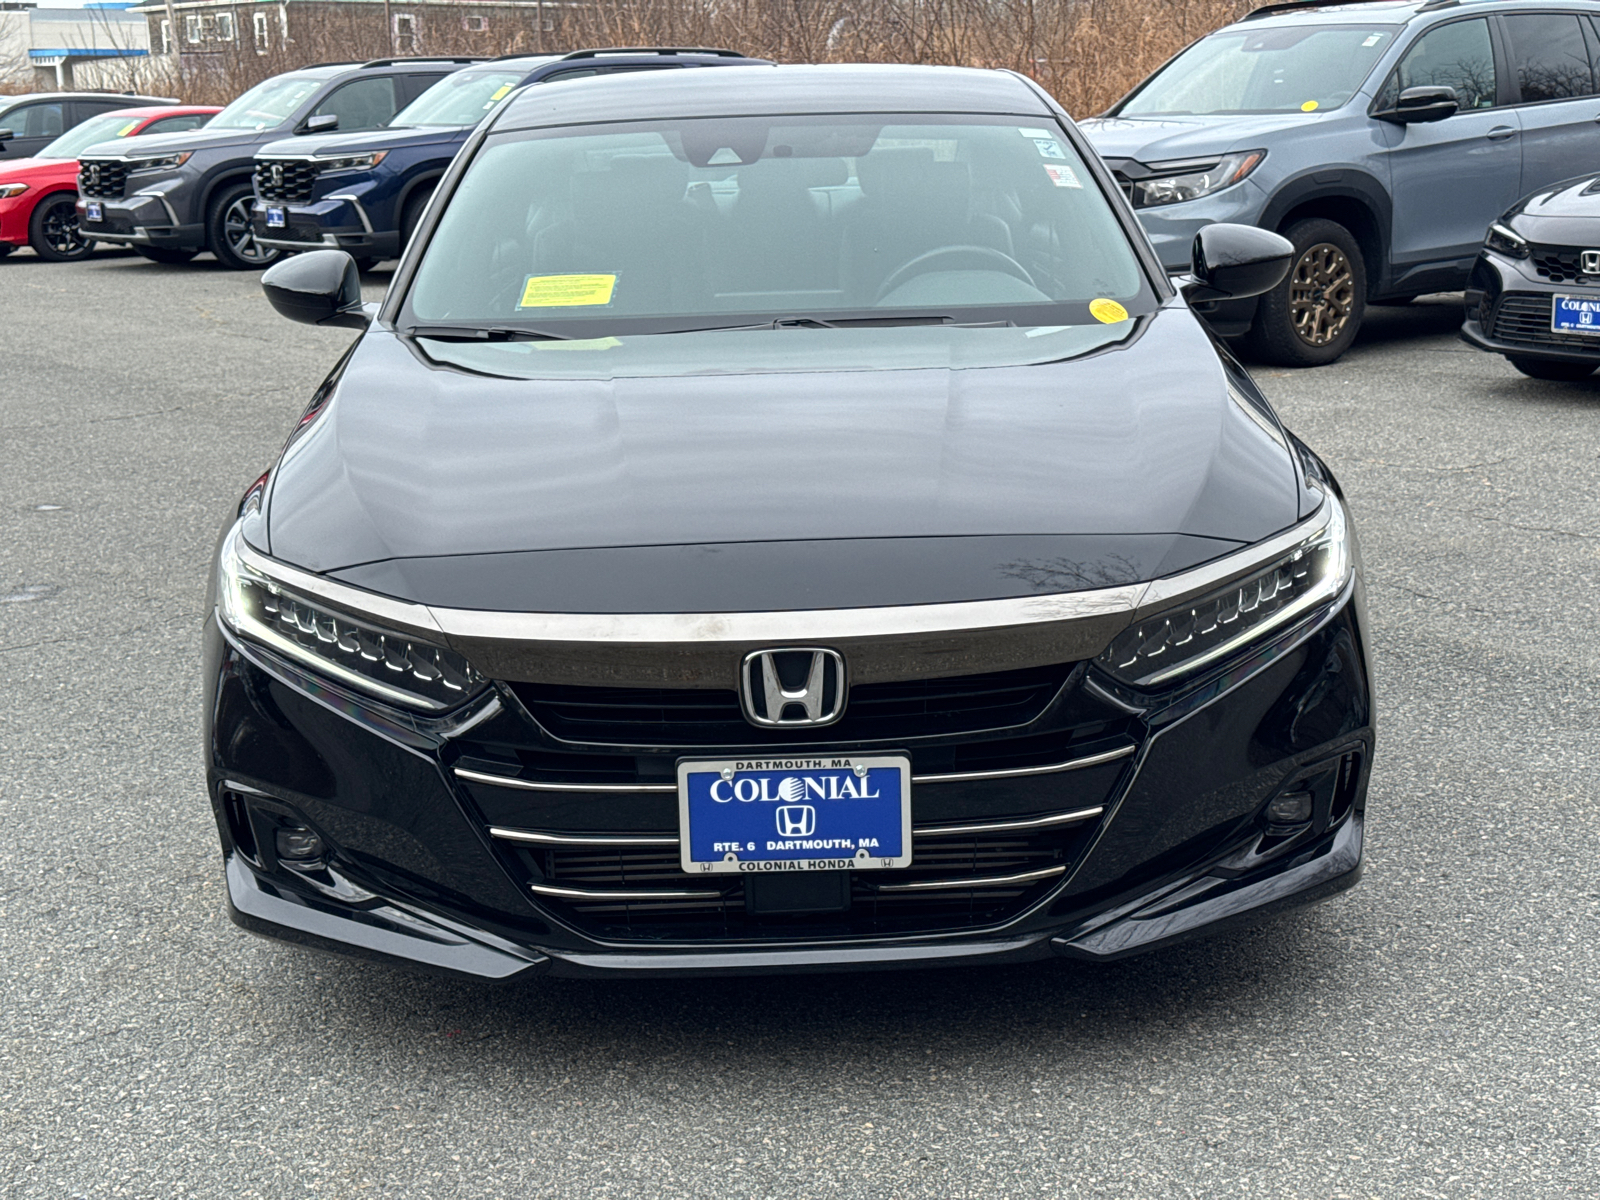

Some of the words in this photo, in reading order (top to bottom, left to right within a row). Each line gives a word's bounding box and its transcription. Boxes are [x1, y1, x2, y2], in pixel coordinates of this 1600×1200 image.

[735, 760, 827, 770] DARTMOUTH,
[831, 759, 852, 768] MA
[709, 775, 880, 803] COLONIAL
[713, 842, 744, 852] RTE.
[747, 842, 756, 851] 6
[766, 839, 855, 850] DARTMOUTH,
[858, 838, 879, 848] MA
[738, 861, 804, 871] COLONIAL
[808, 859, 855, 869] HONDA
